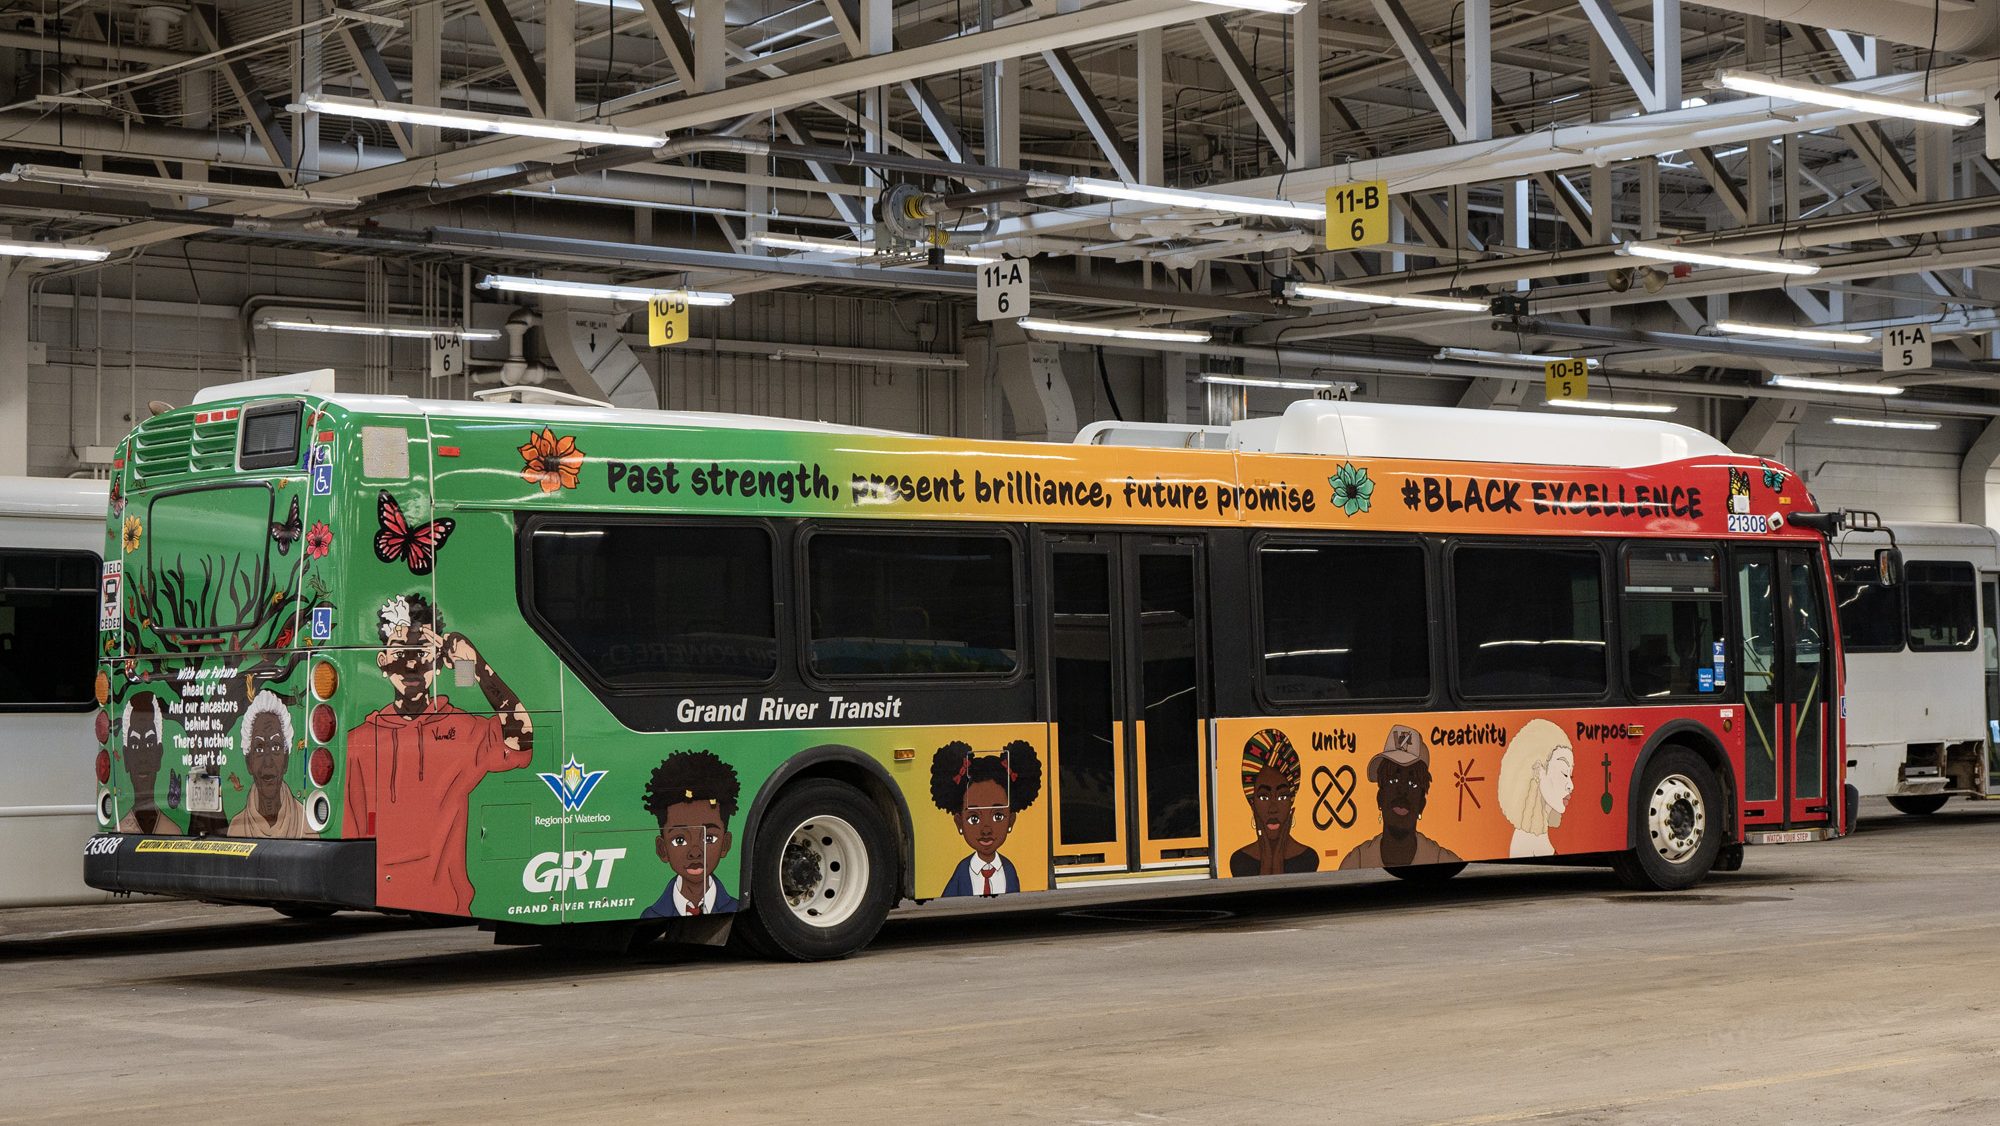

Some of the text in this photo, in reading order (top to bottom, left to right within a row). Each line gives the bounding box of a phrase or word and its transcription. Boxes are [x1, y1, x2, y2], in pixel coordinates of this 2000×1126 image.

[1335, 186, 1379, 213] 11-B
[1351, 218, 1364, 241] 6
[984, 264, 1022, 287] 11-A
[653, 298, 685, 317] 10-B
[998, 292, 1009, 313] 6
[665, 321, 673, 339] 6
[1889, 328, 1925, 346] 11-A
[434, 334, 460, 351] 10-A
[443, 354, 451, 371] 6
[1903, 350, 1913, 366] 5
[1550, 361, 1583, 378] 10-B
[1317, 388, 1348, 401] 10-A
[1563, 382, 1571, 396] 5
[606, 460, 1316, 516] Past strength, present brilliance, future promise
[1401, 477, 1703, 520] #BLACK EXCELLENCE
[1728, 515, 1767, 532] 21308
[103, 562, 121, 574] YIELD
[177, 665, 238, 680] With our future
[182, 681, 227, 696] ahead of us
[169, 698, 238, 714] And our ancestors
[677, 695, 901, 723] Grand River Transit
[184, 716, 210, 731] behind
[173, 733, 233, 750] There's nothing
[1311, 728, 1356, 753] Unity
[1430, 723, 1506, 747] Creativity
[182, 750, 227, 765] we can't do
[535, 813, 611, 827] Region of Waterloo
[84, 837, 123, 855] 21308
[1766, 832, 1808, 843] WATCH YOUR STEP
[522, 847, 627, 893] GRT
[508, 898, 635, 914] GRAND RIVER TRANSIT
